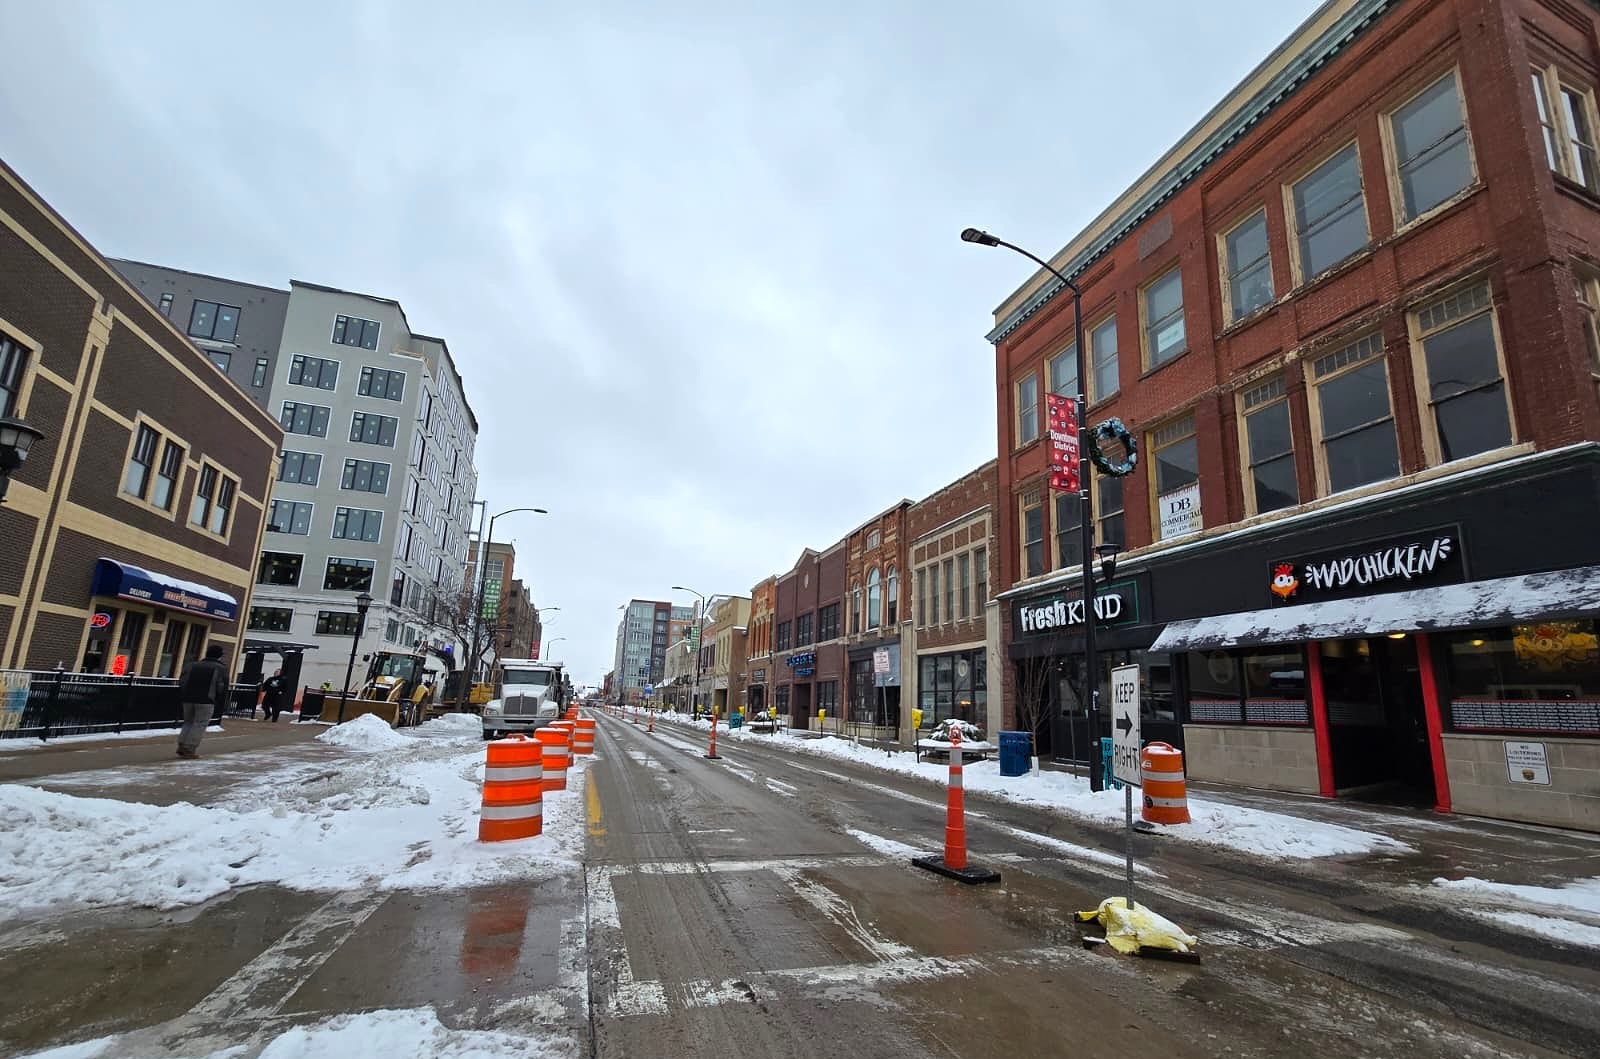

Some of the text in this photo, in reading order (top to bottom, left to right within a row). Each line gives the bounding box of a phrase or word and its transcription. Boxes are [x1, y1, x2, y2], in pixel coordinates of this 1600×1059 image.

[1050, 430, 1078, 446] Downtown
[1054, 441, 1076, 453] District
[1170, 498, 1190, 513] DB
[1161, 510, 1201, 527] COMMERCIAL
[1312, 539, 1439, 589] MADCHICKEN
[1115, 682, 1135, 703] KEEP
[1114, 744, 1138, 771] RIGHT
